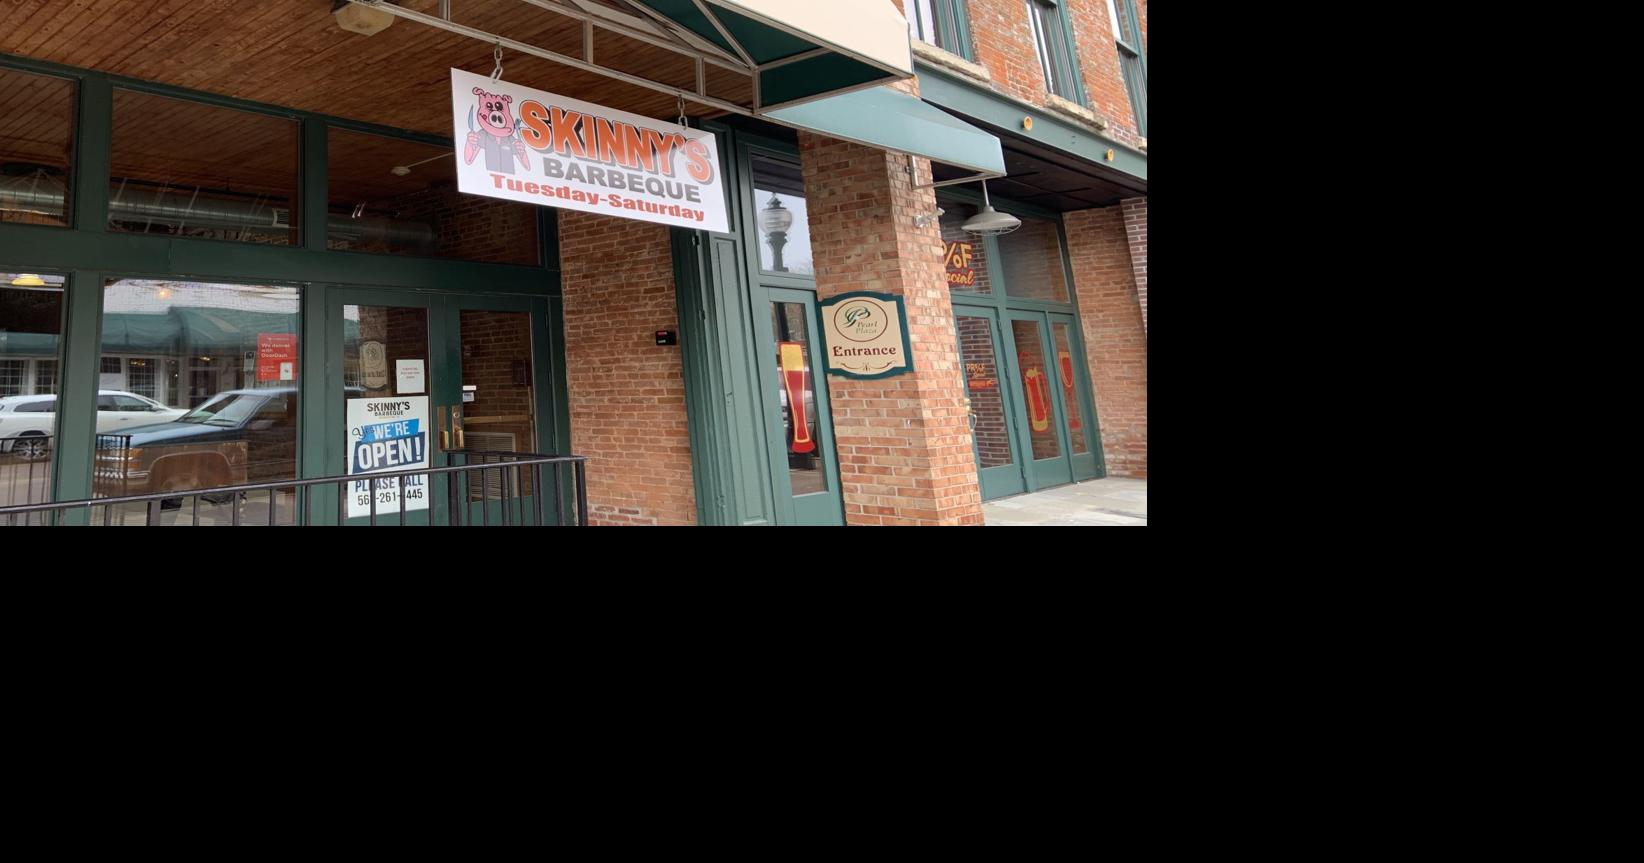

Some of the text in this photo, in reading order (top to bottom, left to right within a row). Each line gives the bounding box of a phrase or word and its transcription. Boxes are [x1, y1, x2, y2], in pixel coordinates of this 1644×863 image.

[518, 99, 714, 184] SKINNY'S
[543, 157, 701, 203] BARBEQUE
[490, 173, 705, 222] Tuesday-Saturday
[832, 345, 897, 357] Entrance
[367, 401, 410, 412] SKINNY'S
[373, 421, 410, 440] WE'RE
[358, 436, 421, 469] OPEN!
[355, 474, 423, 492] PLASE ALL
[358, 488, 423, 506] 56-261-445
